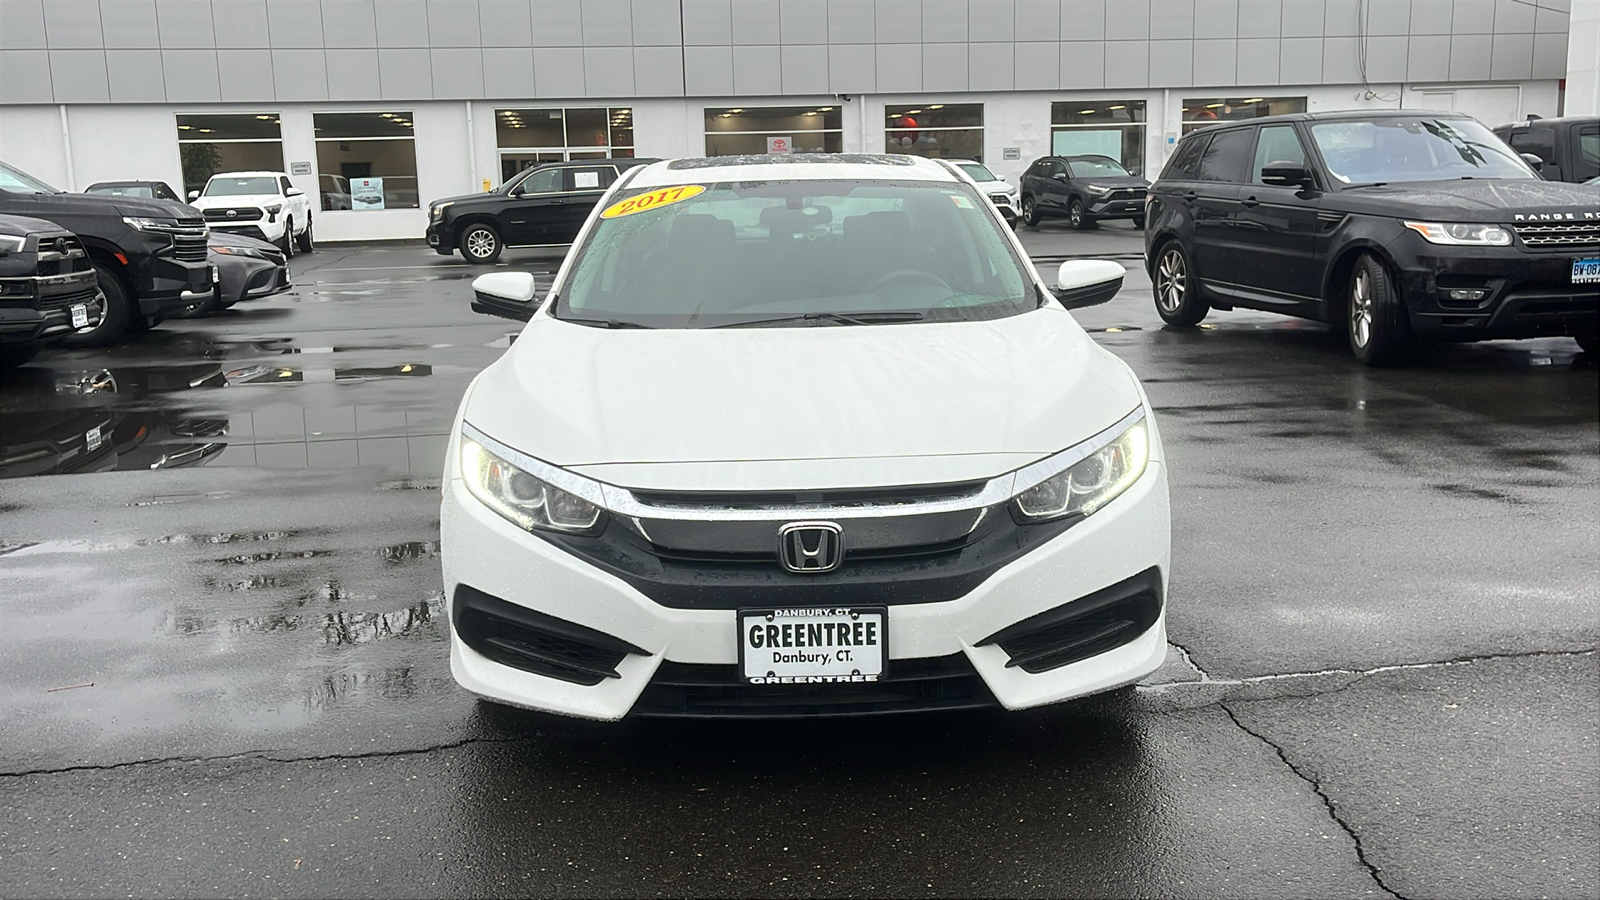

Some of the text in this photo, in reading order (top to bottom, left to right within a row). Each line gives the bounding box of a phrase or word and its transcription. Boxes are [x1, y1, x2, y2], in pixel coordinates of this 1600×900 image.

[619, 188, 686, 214] 2017
[774, 608, 851, 618] DANBURY, CT
[749, 622, 876, 648] GREENTREE
[773, 650, 853, 666] Danbury, CT.
[750, 675, 878, 684] GREENTREE
